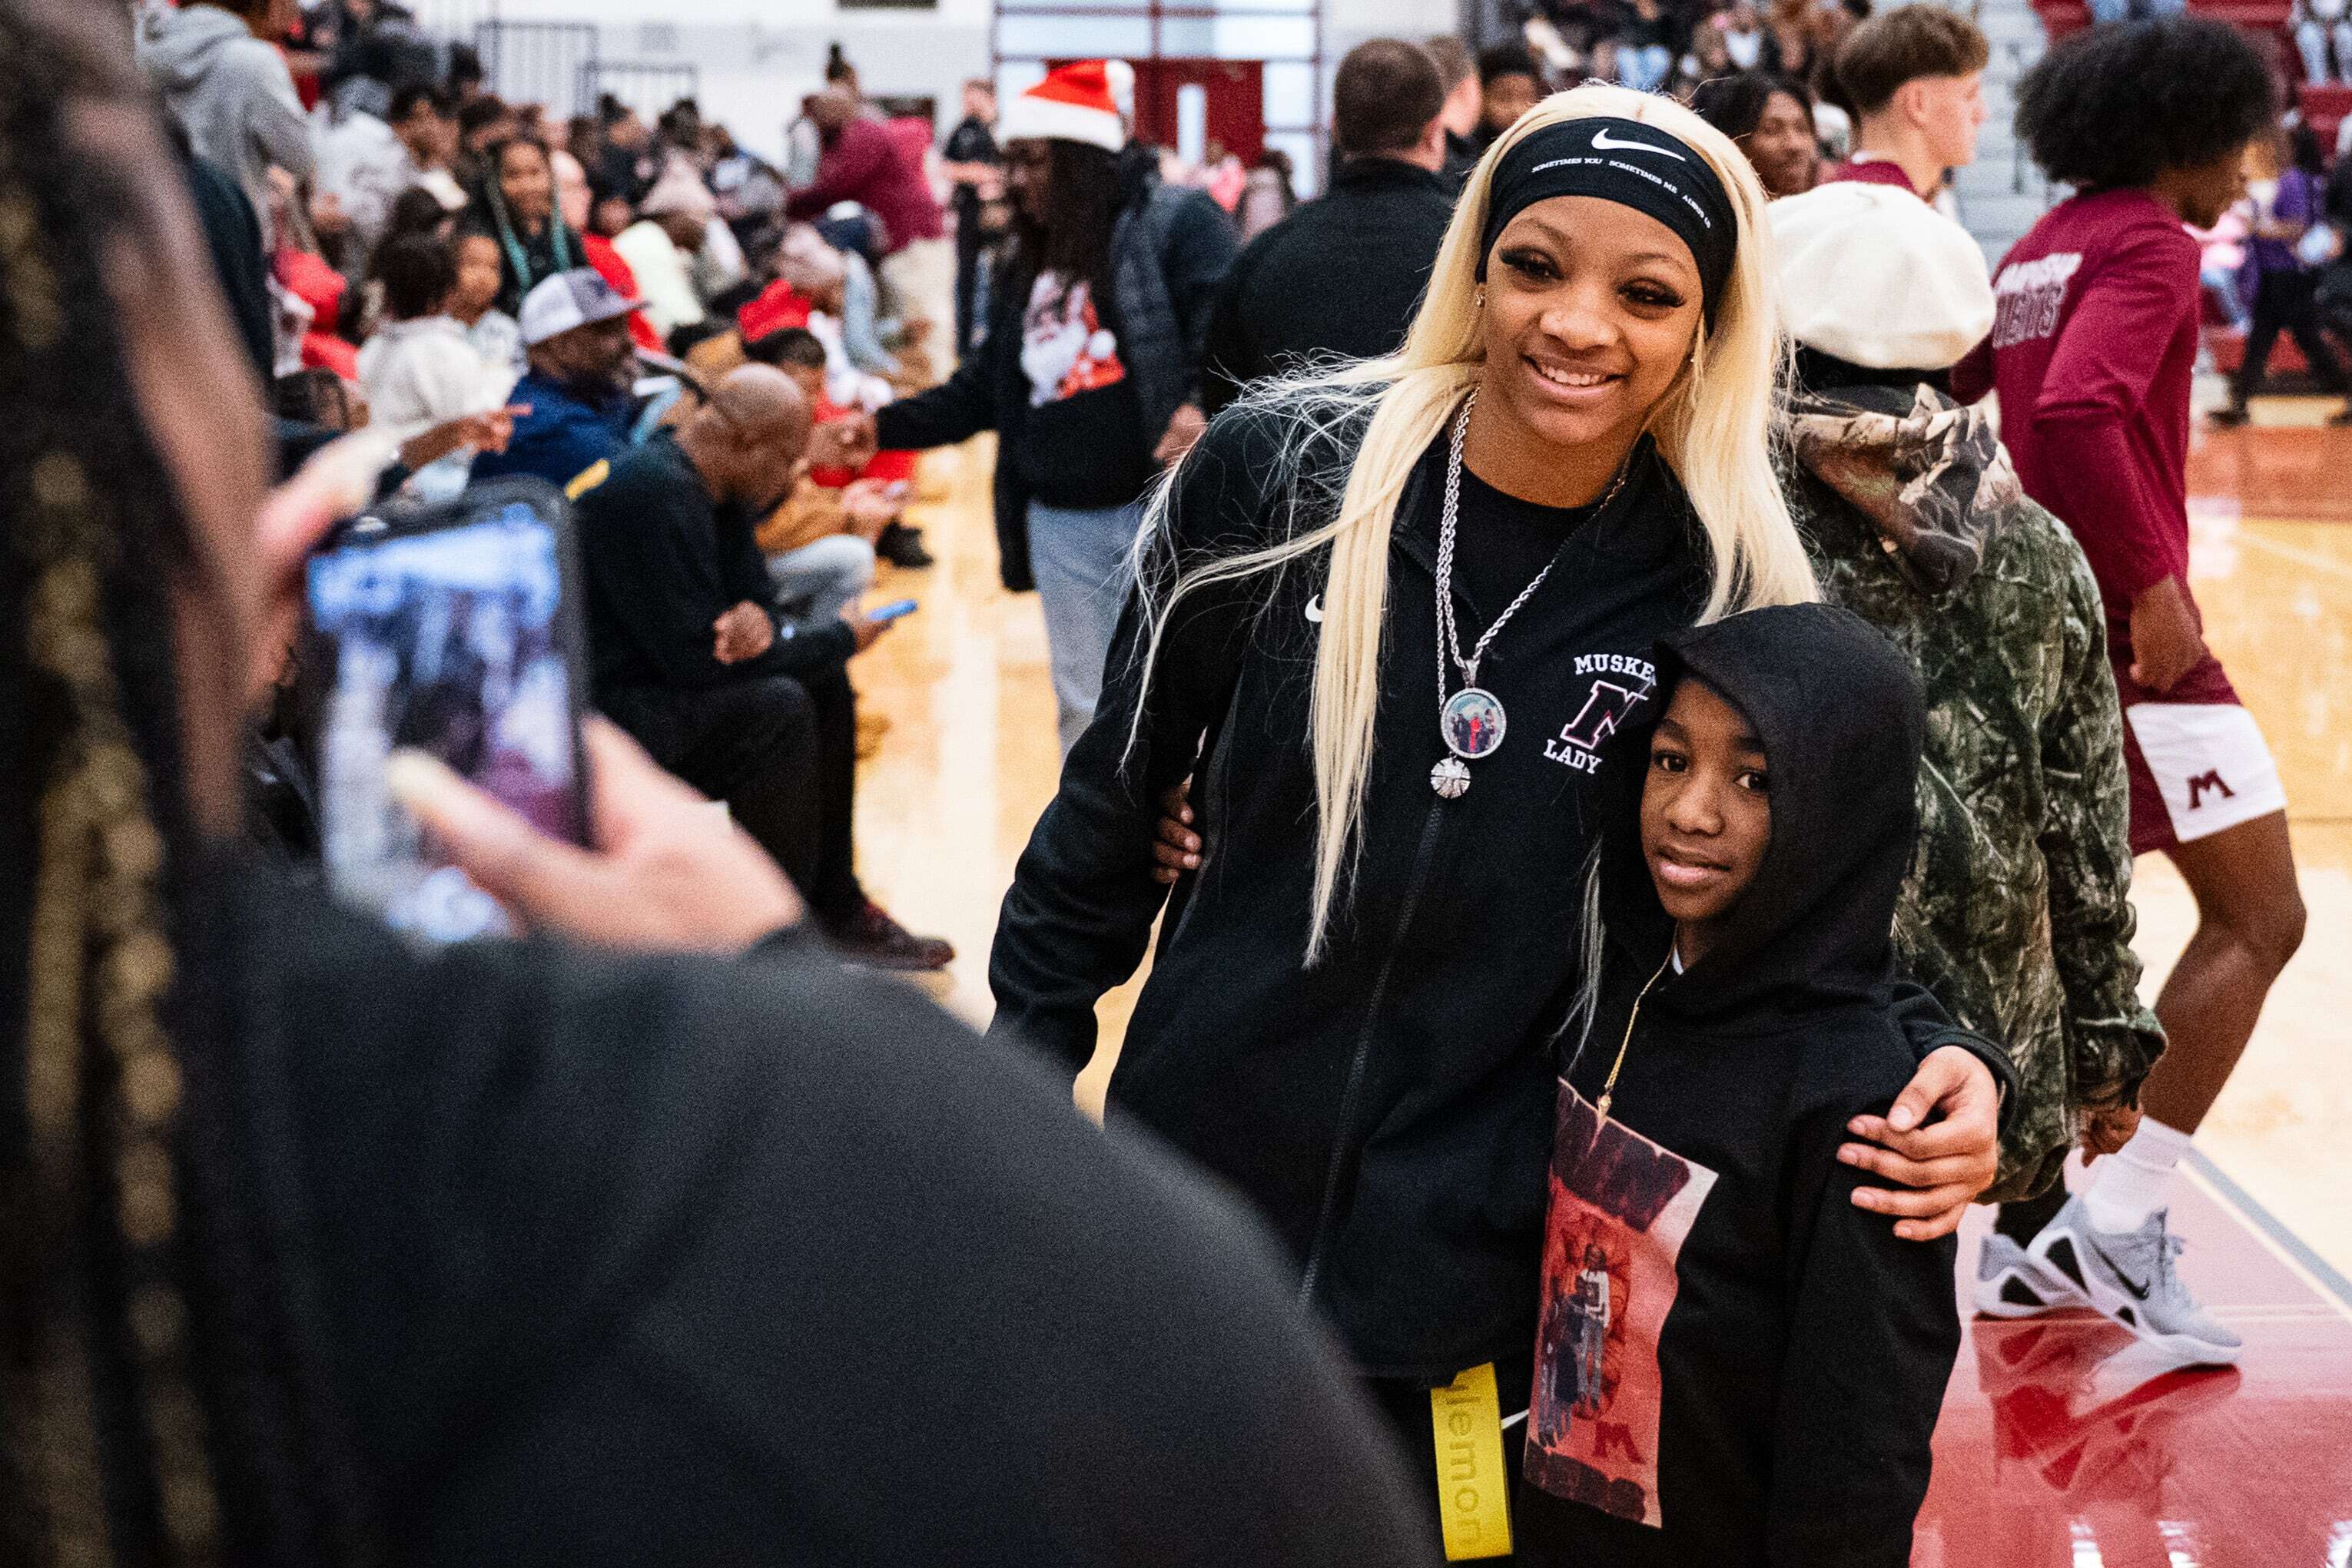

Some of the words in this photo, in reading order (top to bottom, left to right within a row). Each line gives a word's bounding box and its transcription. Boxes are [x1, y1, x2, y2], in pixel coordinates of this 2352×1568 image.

[1531, 157, 1583, 173] SOMETIMES
[1608, 160, 1663, 184] SOMETIMES
[1664, 181, 1678, 194] ME
[1543, 738, 1603, 774] LADY
[2187, 767, 2236, 810] M
[1593, 1421, 1647, 1465] M
